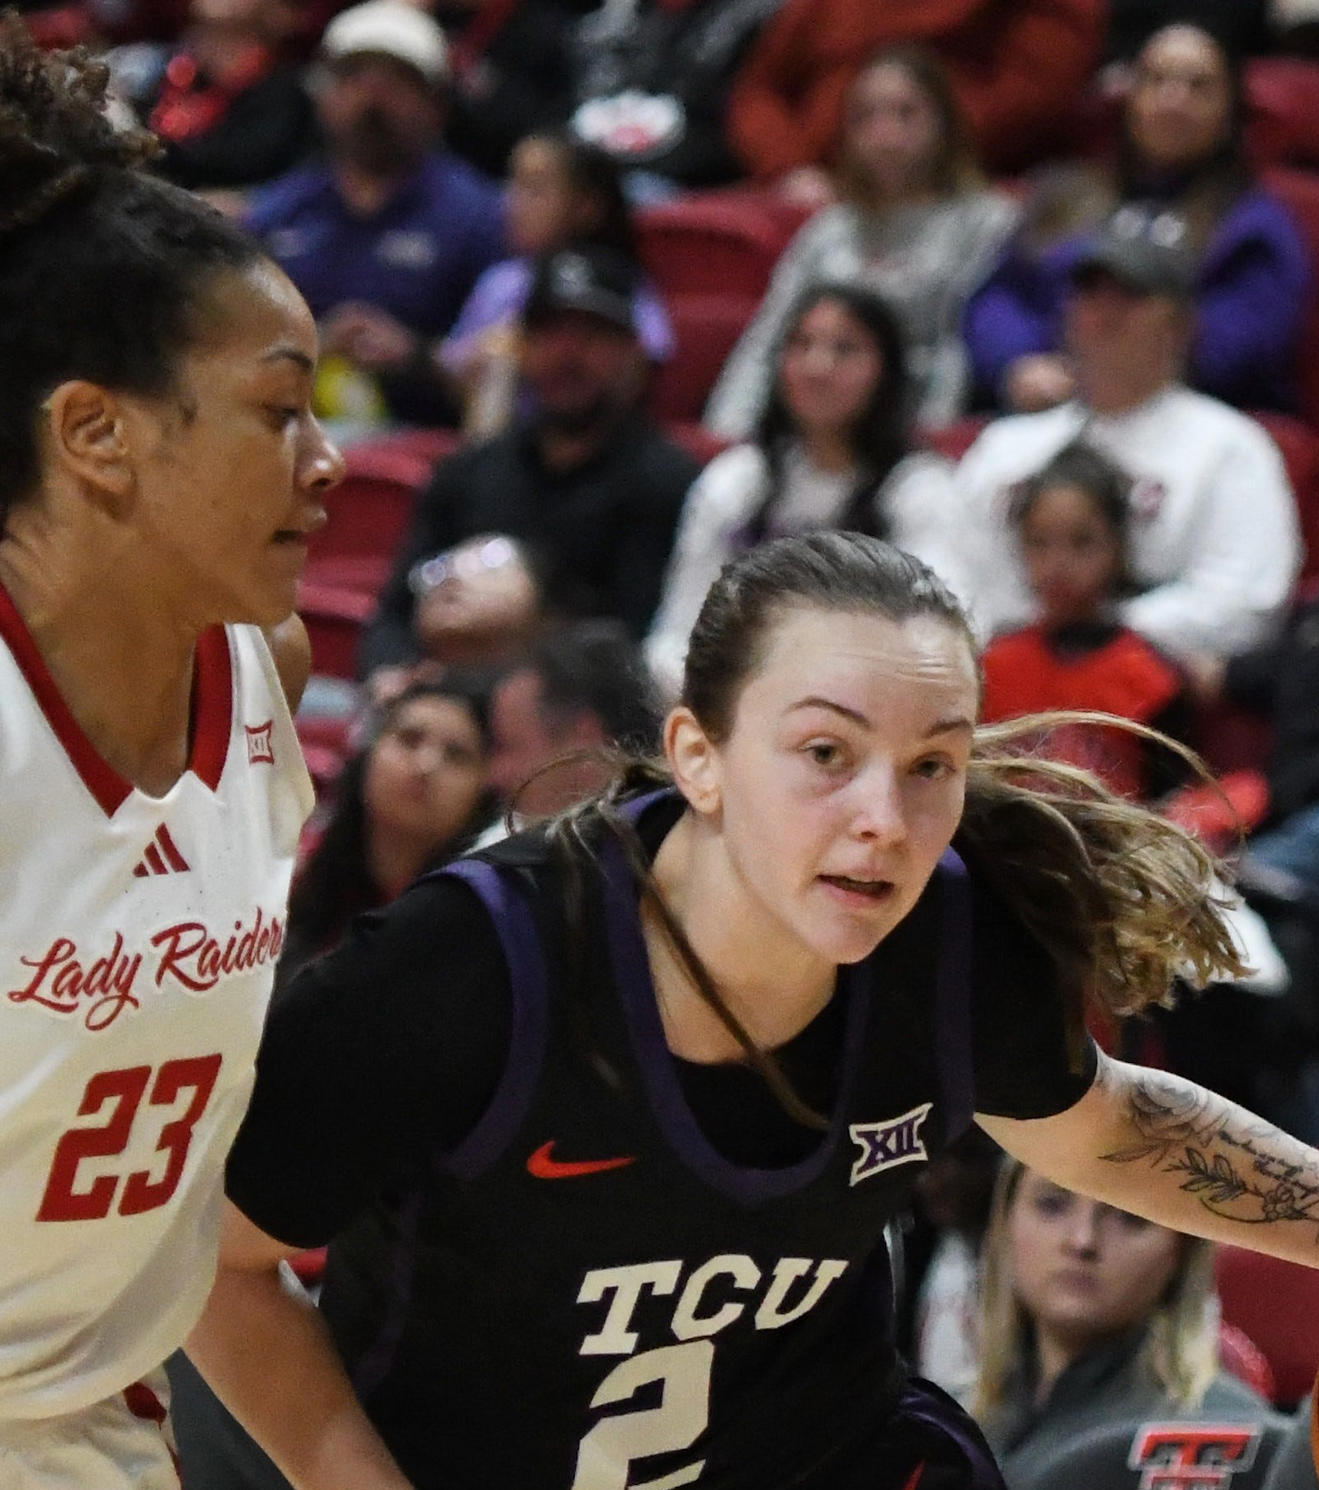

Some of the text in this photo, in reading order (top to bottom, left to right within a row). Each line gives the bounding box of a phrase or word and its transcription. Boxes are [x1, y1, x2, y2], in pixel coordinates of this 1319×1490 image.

[7, 930, 143, 1032] Lady
[34, 1052, 223, 1223] 23
[855, 1111, 926, 1176] XII
[575, 1253, 850, 1356] TCU
